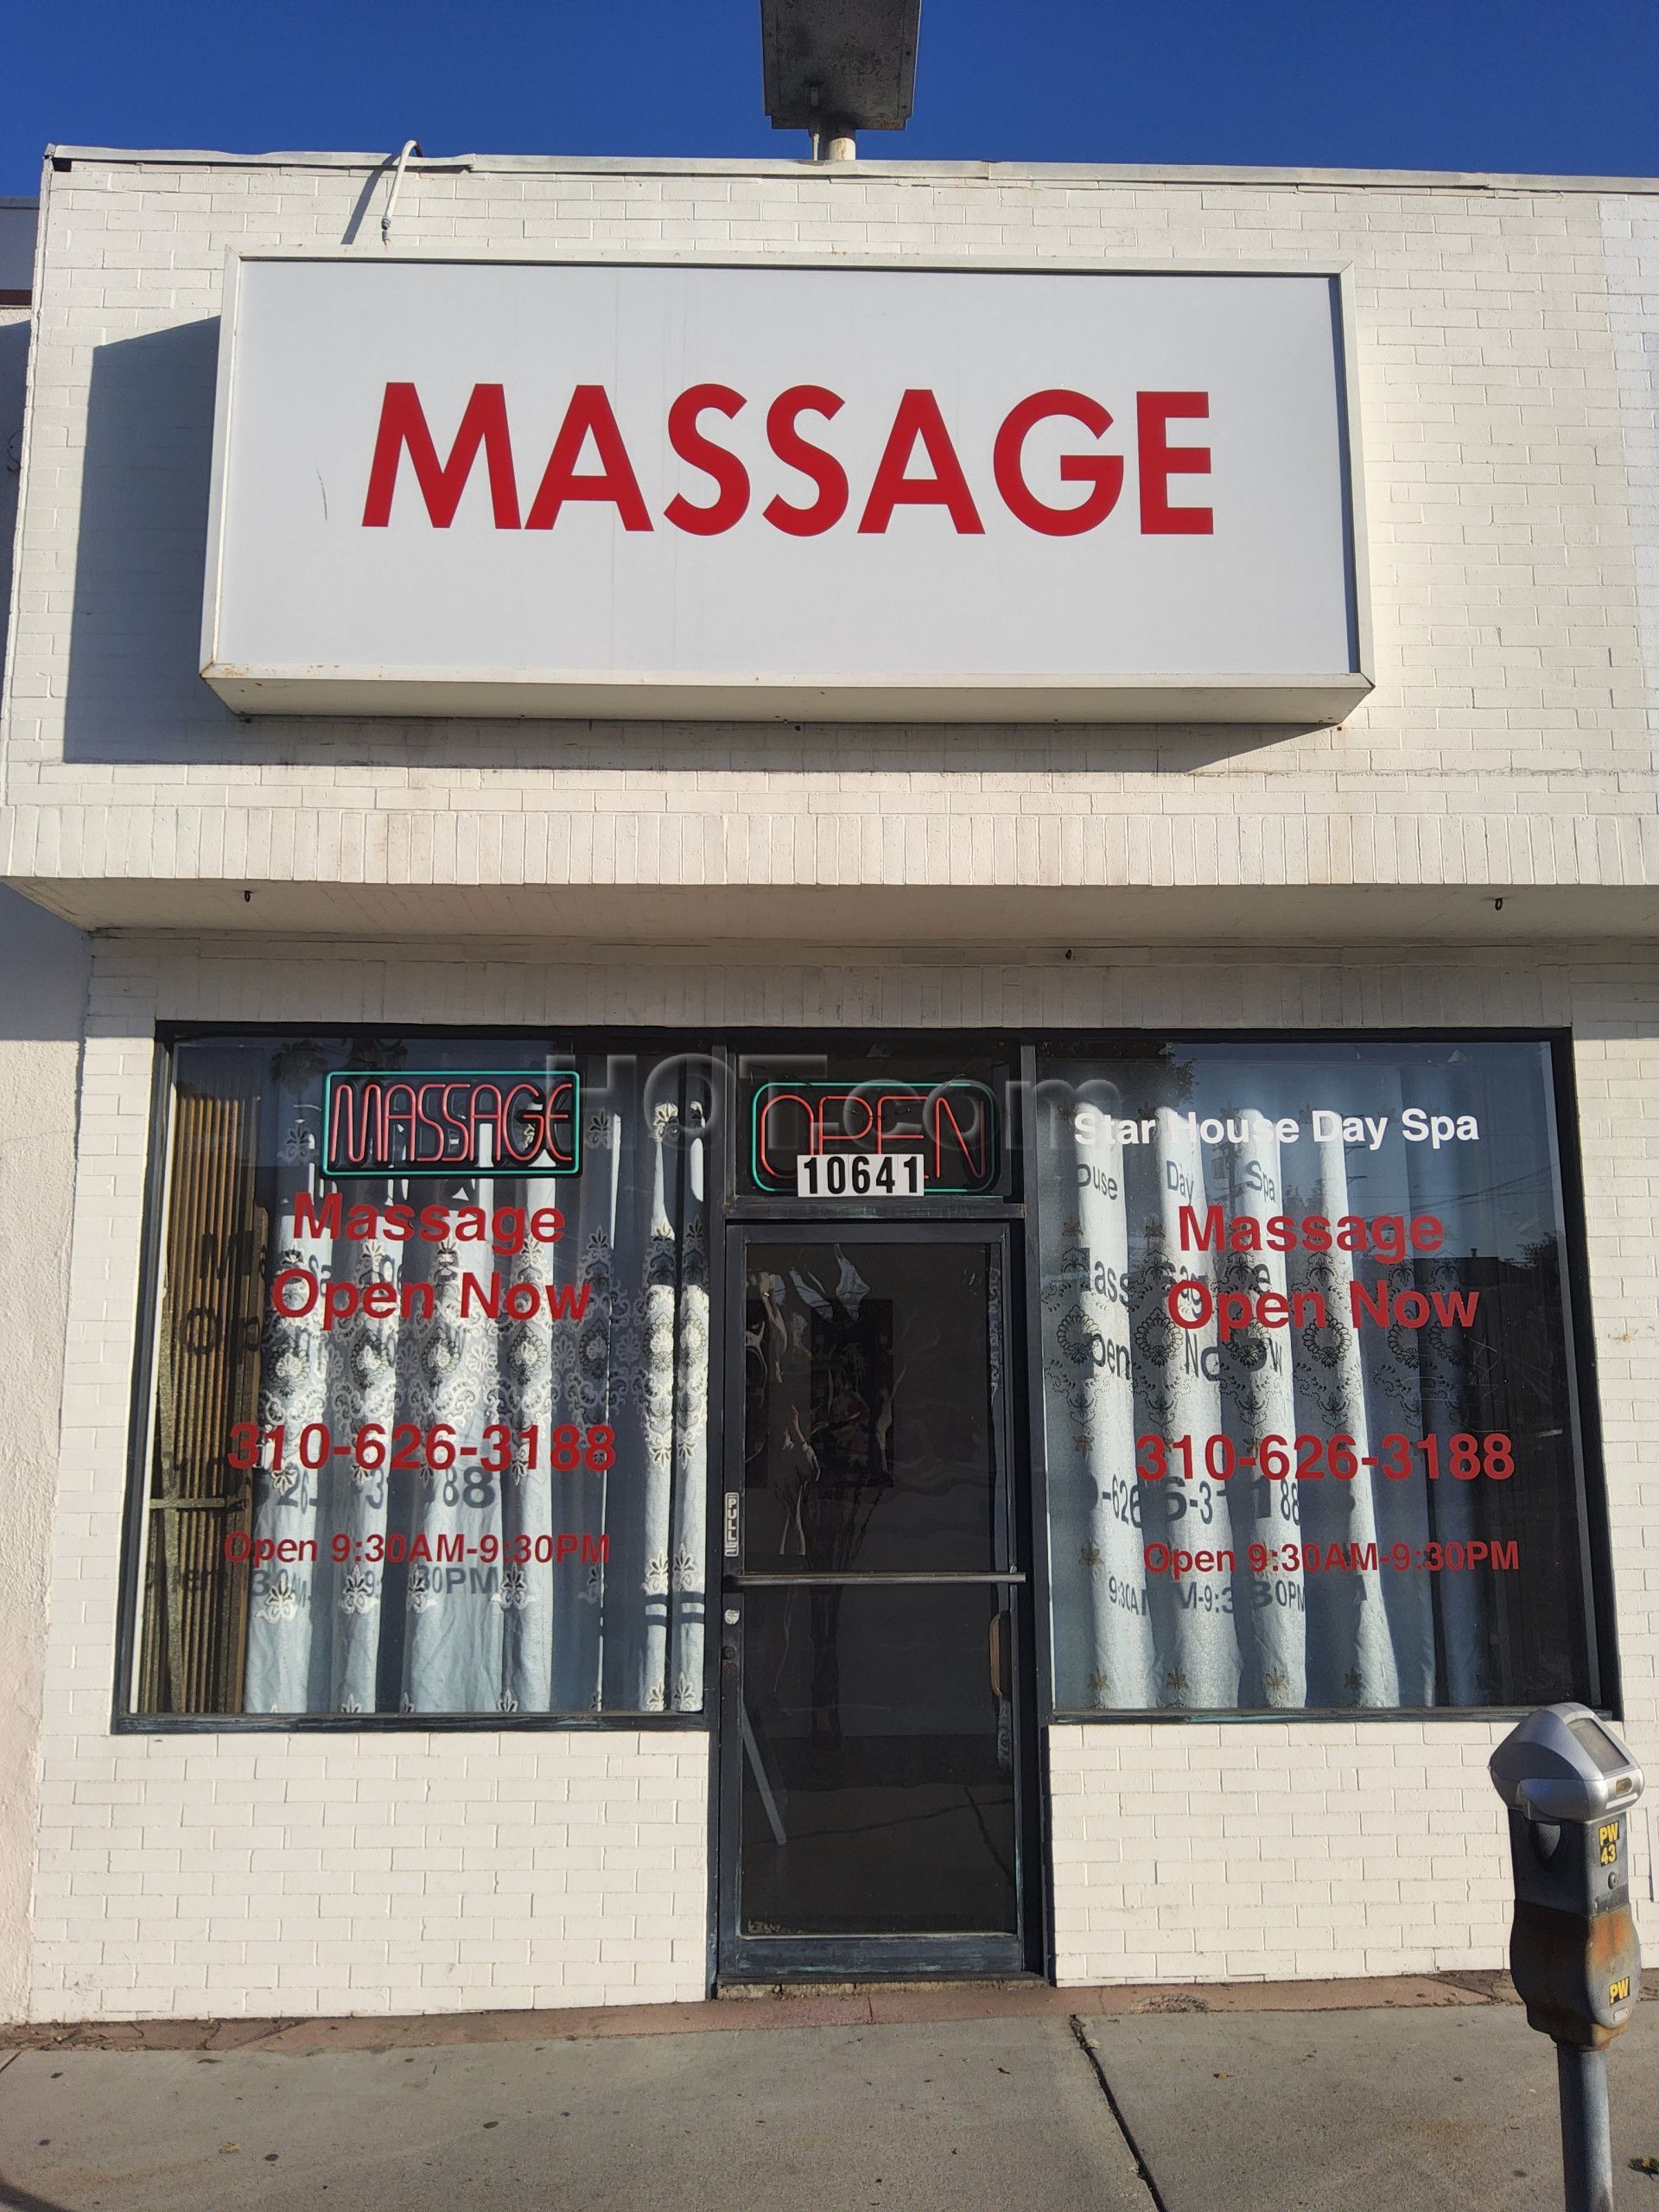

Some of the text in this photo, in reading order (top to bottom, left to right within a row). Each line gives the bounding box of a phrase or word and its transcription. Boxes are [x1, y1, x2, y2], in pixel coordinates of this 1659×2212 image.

[361, 381, 1215, 537] MASSAGE
[330, 1082, 573, 1162] MASSAGE
[760, 1093, 986, 1179] OPEN
[1074, 1107, 1479, 1151] Star House Day Spa
[803, 1155, 918, 1194] 10641
[292, 1192, 566, 1256] Massage
[1179, 1205, 1445, 1265] Massage
[272, 1268, 435, 1332] Open
[460, 1271, 593, 1322] Now
[1166, 1279, 1327, 1342] Open
[1350, 1279, 1479, 1329] Now
[226, 1421, 616, 1472] 310-626-3188
[1136, 1433, 1516, 1482] 310-626-3188
[728, 1497, 738, 1541] PULL
[223, 1530, 610, 1569] Open 9:30AM-9:30PM
[1143, 1540, 1520, 1581] Open 9:30AM-9:30PM
[1599, 1821, 1618, 1847] PW
[1600, 1844, 1616, 1865] 43
[1610, 1977, 1629, 2005] PW
